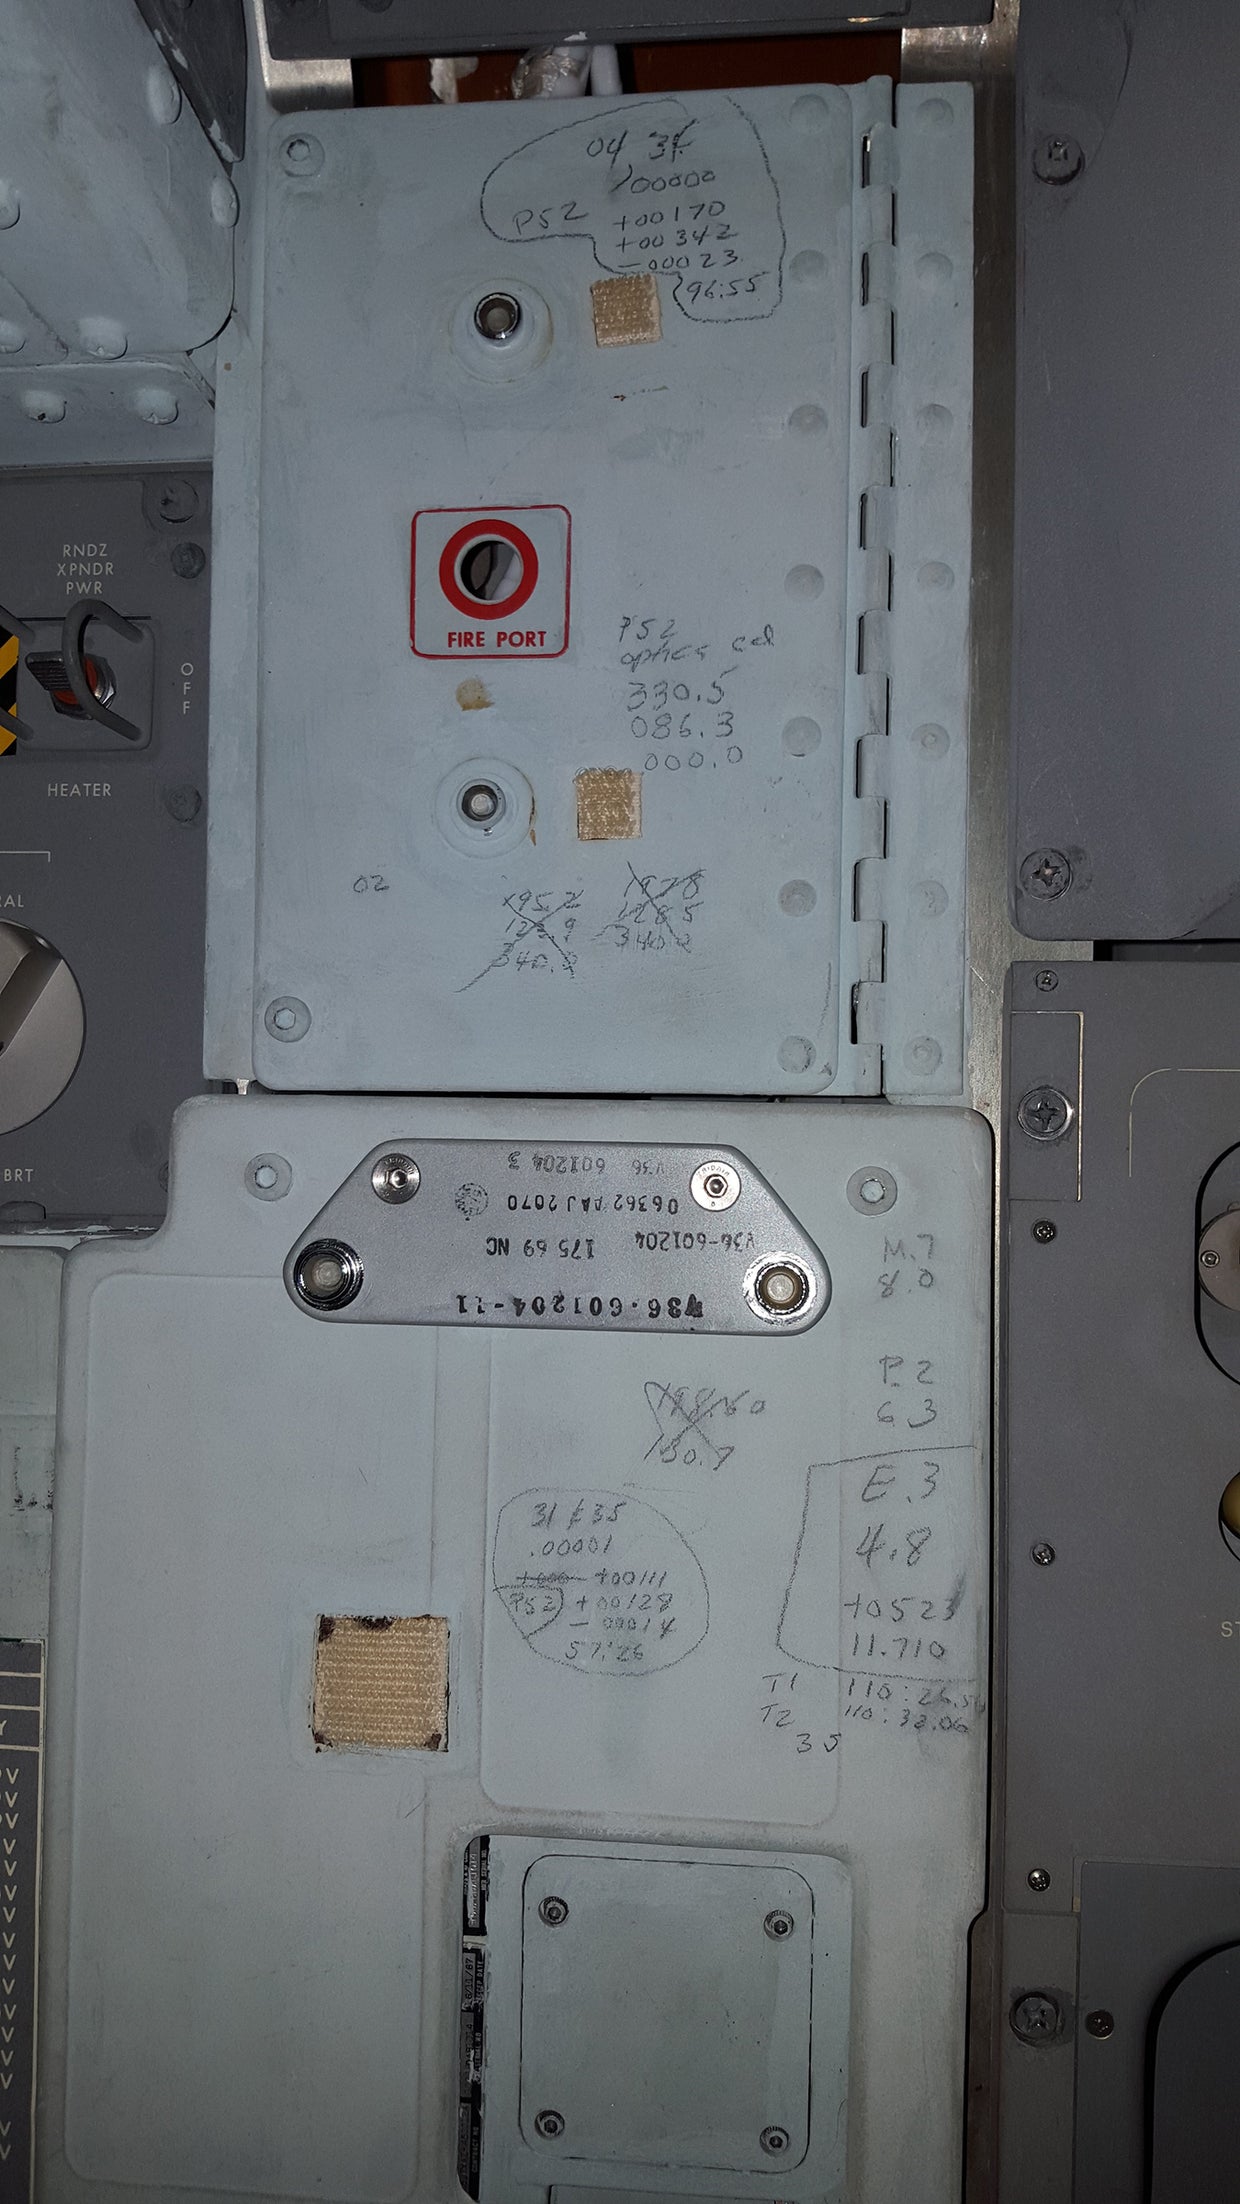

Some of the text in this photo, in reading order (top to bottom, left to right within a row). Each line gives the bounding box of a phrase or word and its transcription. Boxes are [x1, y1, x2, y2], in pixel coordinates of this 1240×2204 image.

[63, 544, 108, 557] RNDZ
[57, 563, 114, 576] XPNDR
[66, 582, 103, 595] PWR
[447, 631, 547, 648] FIRE PORT
[180, 662, 194, 715] OFF
[644, 745, 743, 771] 000.0
[47, 784, 112, 797] HEATER
[3, 1168, 34, 1183] BRT
[507, 1193, 558, 1212] 2070
[613, 1193, 679, 1216] 06362
[485, 1236, 510, 1256] NC
